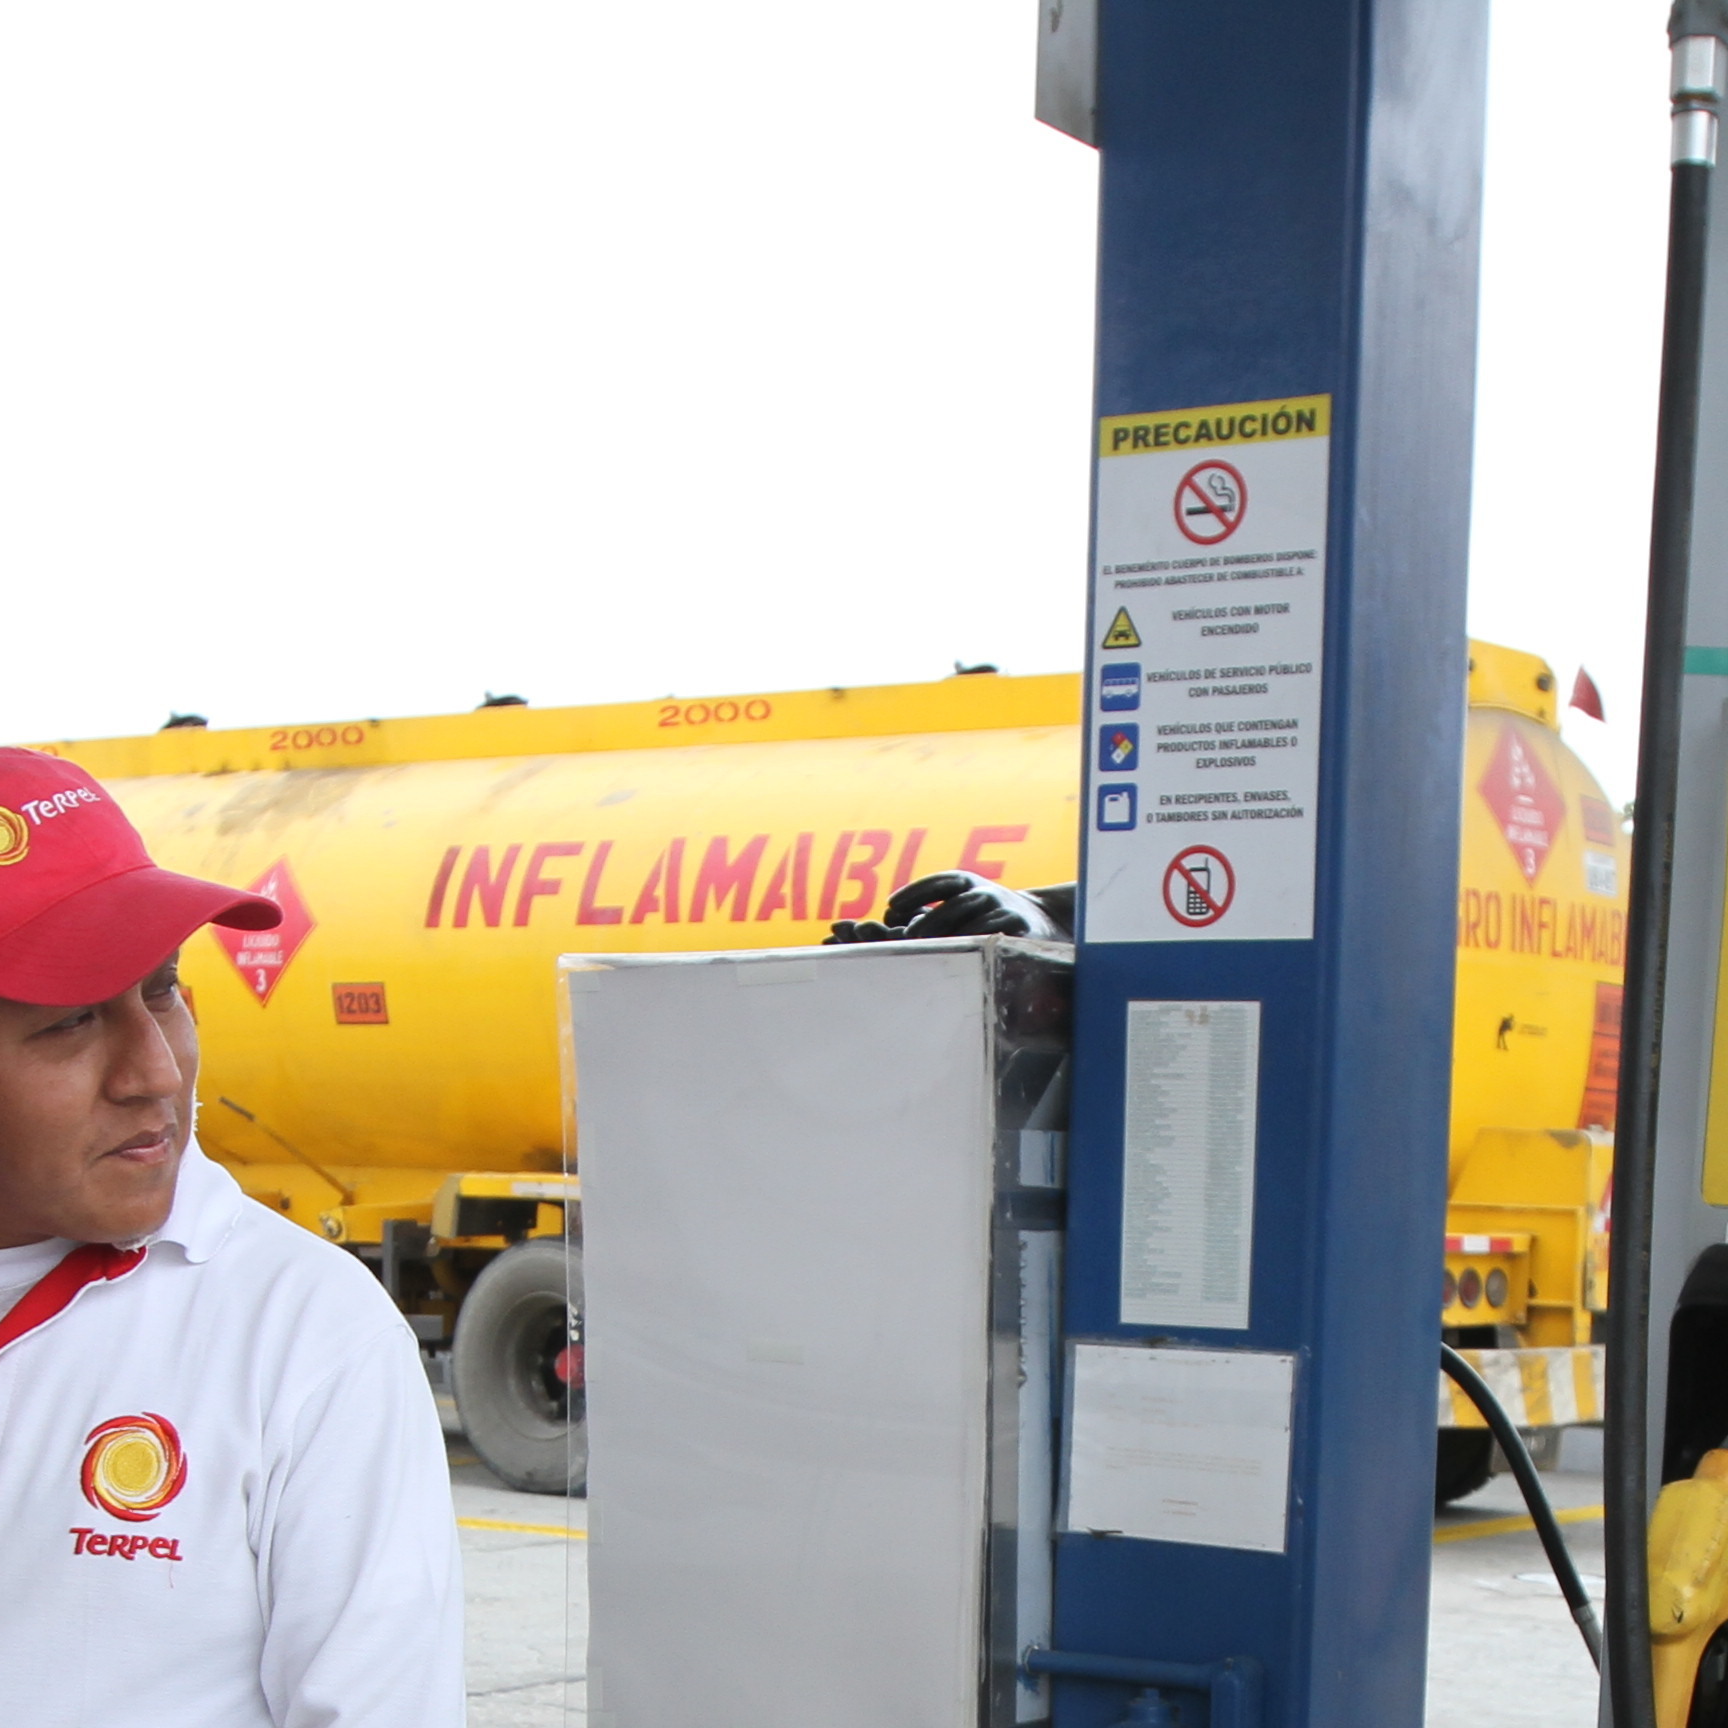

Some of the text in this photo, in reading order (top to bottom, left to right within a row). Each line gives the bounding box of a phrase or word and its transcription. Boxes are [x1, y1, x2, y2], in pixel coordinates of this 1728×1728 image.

[1112, 406, 1317, 451] PRECAUCIÓN
[1172, 557, 1208, 571] CUERPO
[1209, 556, 1222, 568] DE
[1223, 553, 1275, 567] BOMBEROS
[1114, 577, 1163, 590] PROHIBIDO
[1164, 573, 1215, 587] ABASTECER
[1216, 571, 1229, 582] DE
[1230, 567, 1294, 581] COMBUSTIBLE
[1172, 603, 1290, 621] VEHÍCULOS CON MOTOR
[1201, 622, 1259, 637] ENCENDIDO
[1147, 661, 1313, 683] VEHÍCULOS DE SERVICIO PÚBLICO
[1188, 683, 1269, 698] CON PASAJEROS
[658, 698, 774, 729] 2000
[1157, 718, 1299, 736] VEHÍCULOS QUE CONTENGAN
[270, 724, 366, 752] 2000
[1157, 740, 1216, 753] PRODUCTOS
[1218, 736, 1289, 751] INFLAMABLES
[1196, 755, 1256, 769] EXPLOSIVOS
[1160, 794, 1173, 806] EN
[1155, 810, 1209, 823] TAMBORES
[1211, 809, 1229, 821] SIN
[1230, 803, 1304, 820] AUTORIZACIÓN
[255, 968, 267, 993] 3
[337, 992, 383, 1015] 1203
